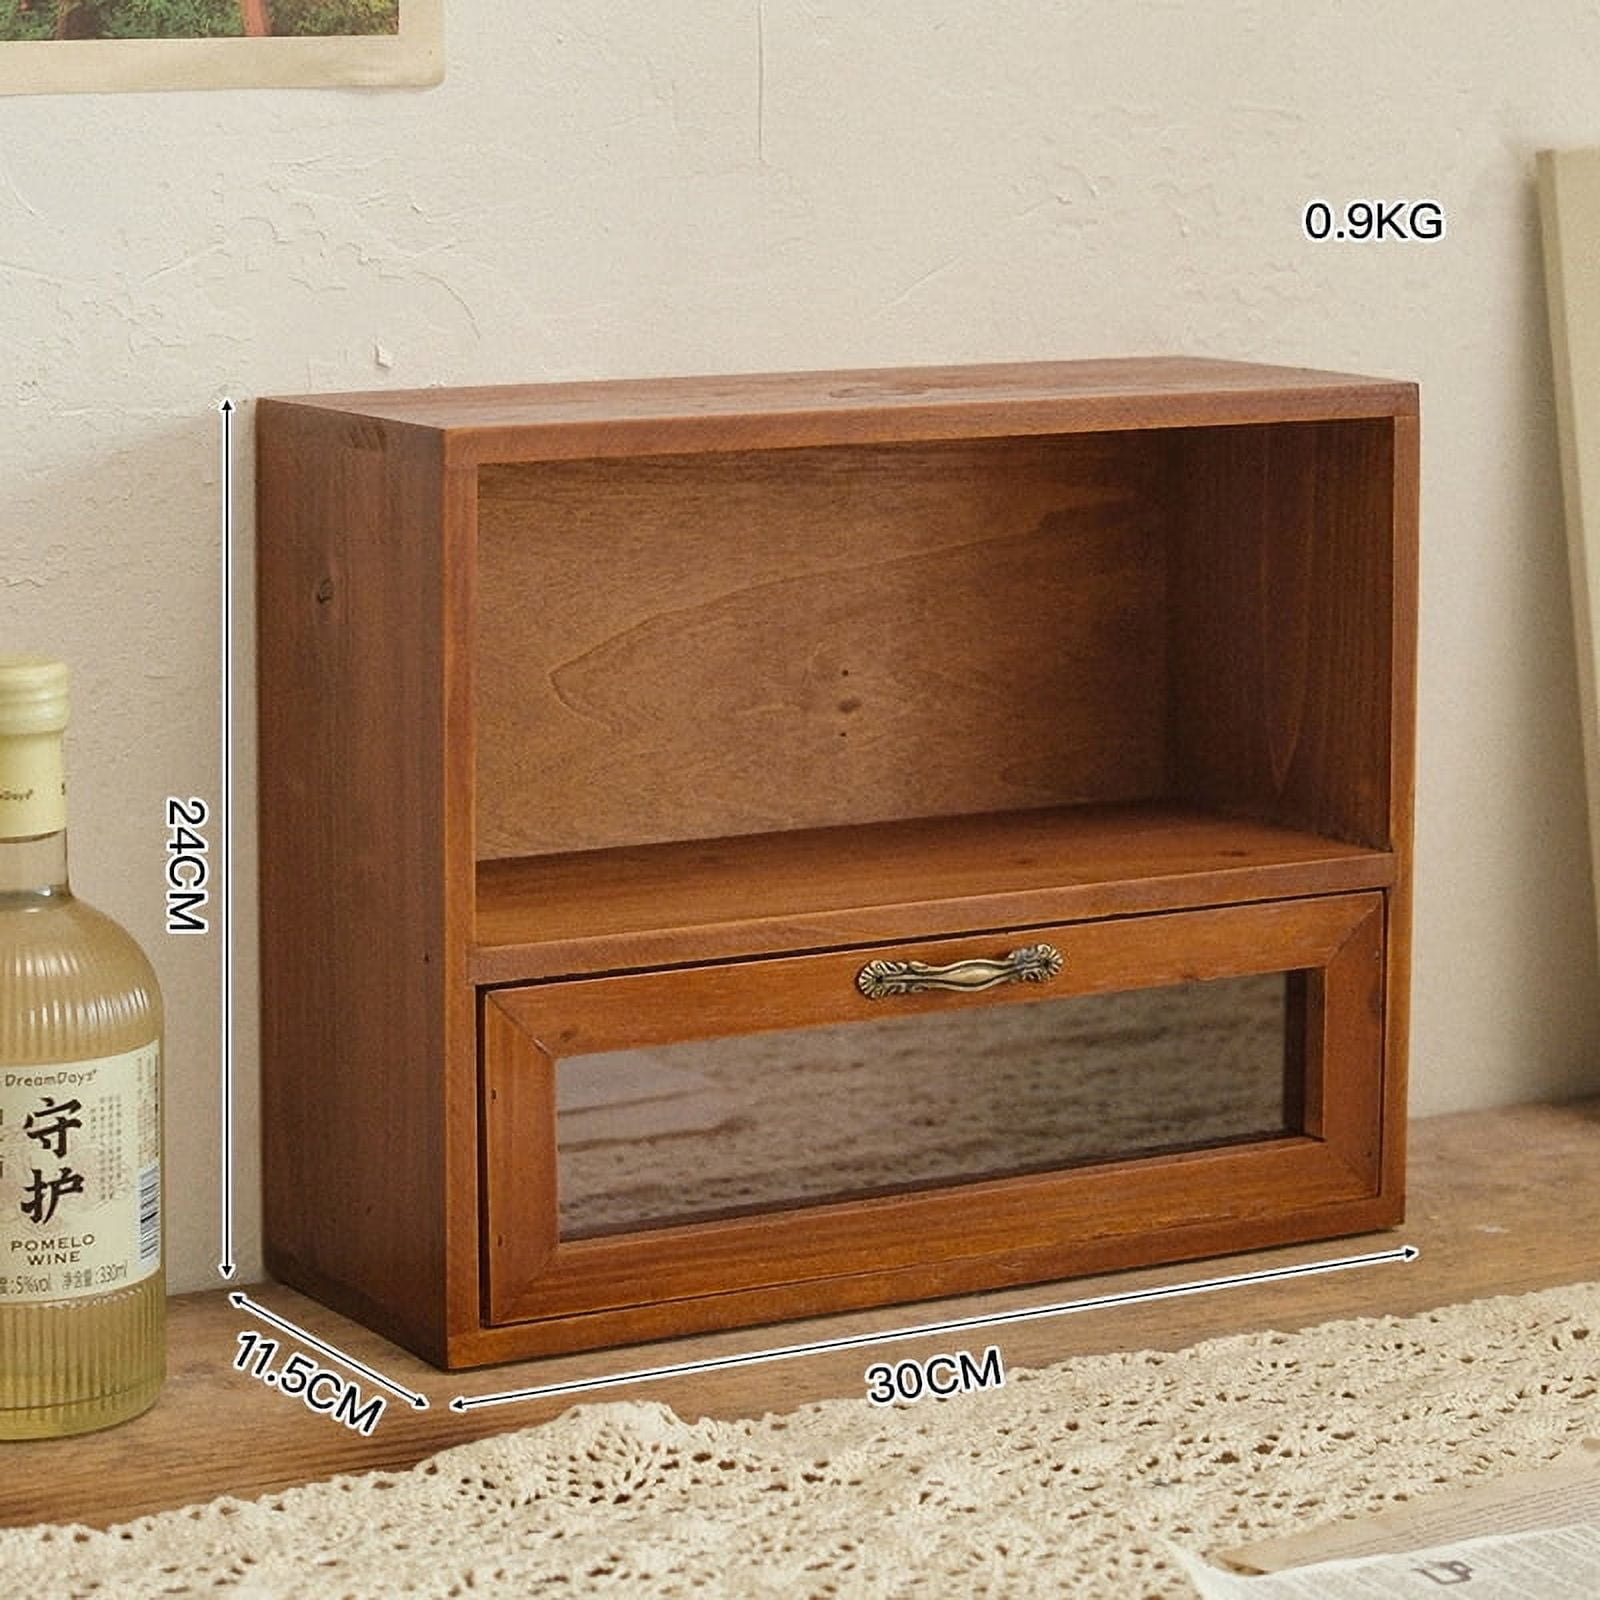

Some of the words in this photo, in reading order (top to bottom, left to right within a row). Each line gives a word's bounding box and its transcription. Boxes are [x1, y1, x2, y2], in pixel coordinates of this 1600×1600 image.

[20, 1096, 84, 1225] 守护
[10, 1233, 96, 1252] POMELO
[27, 1250, 81, 1266] WINE
